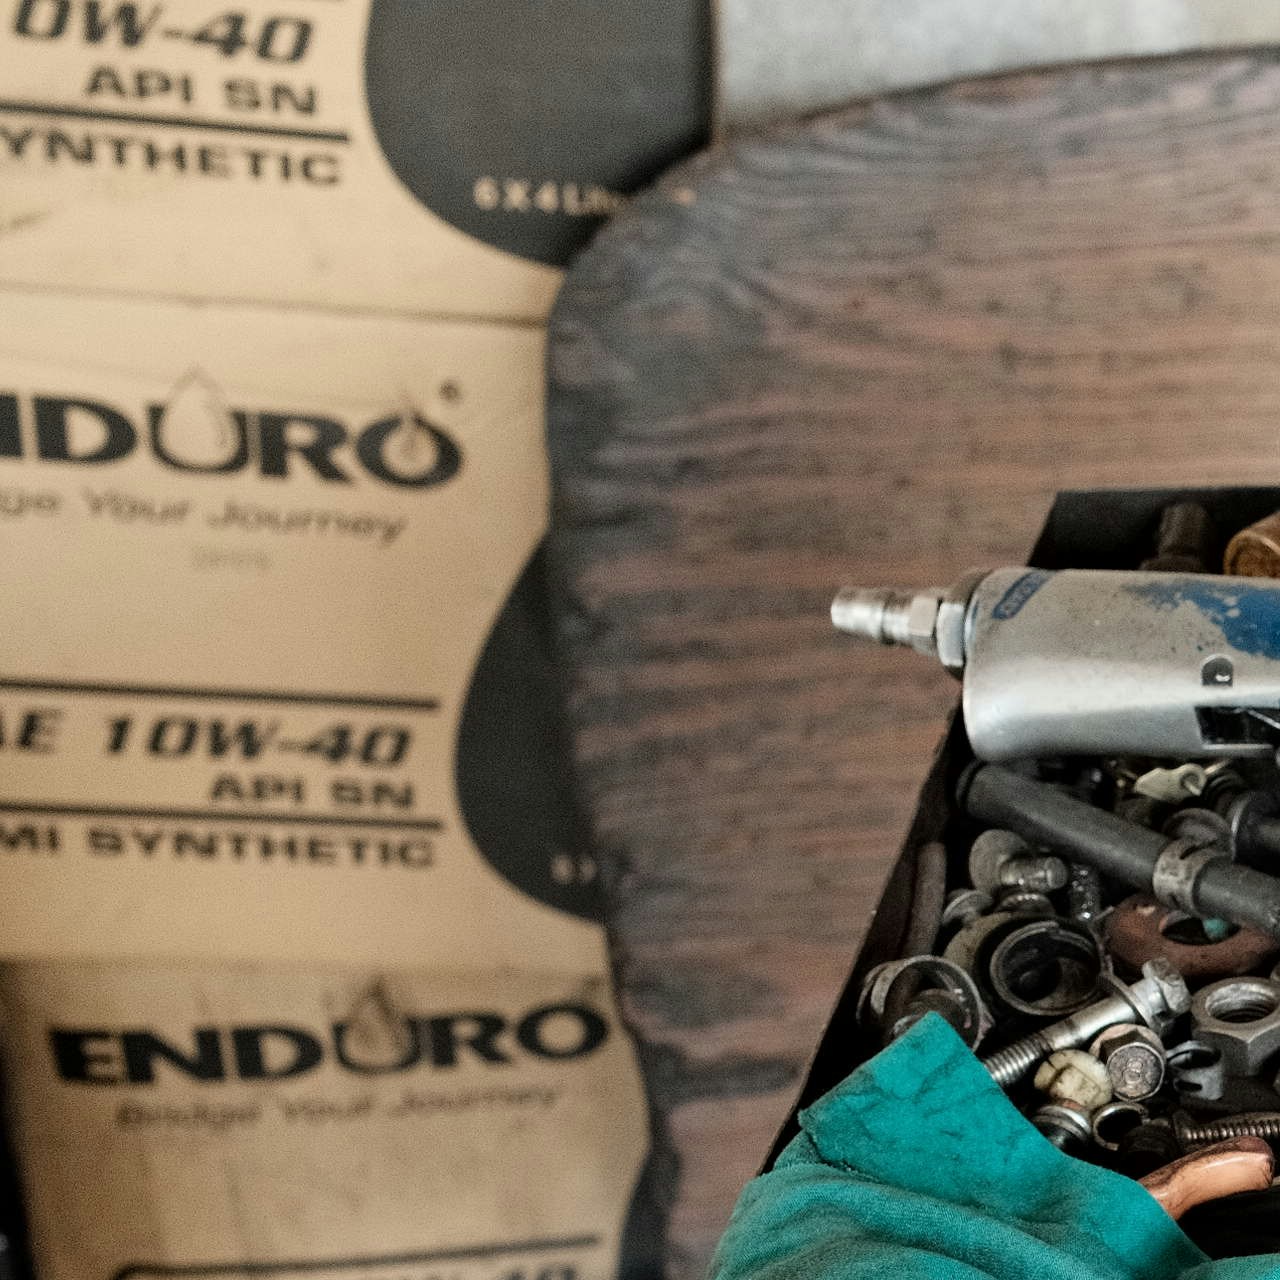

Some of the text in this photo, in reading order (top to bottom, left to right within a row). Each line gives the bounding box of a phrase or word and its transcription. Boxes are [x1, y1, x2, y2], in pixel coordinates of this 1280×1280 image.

[85, 64, 318, 116] API SN
[206, 500, 407, 546] Journey
[0, 708, 412, 768] E 10W-40
[210, 772, 416, 810] API SN
[87, 826, 437, 870] SYNTHETIC
[48, 1002, 612, 1086] ENDURO
